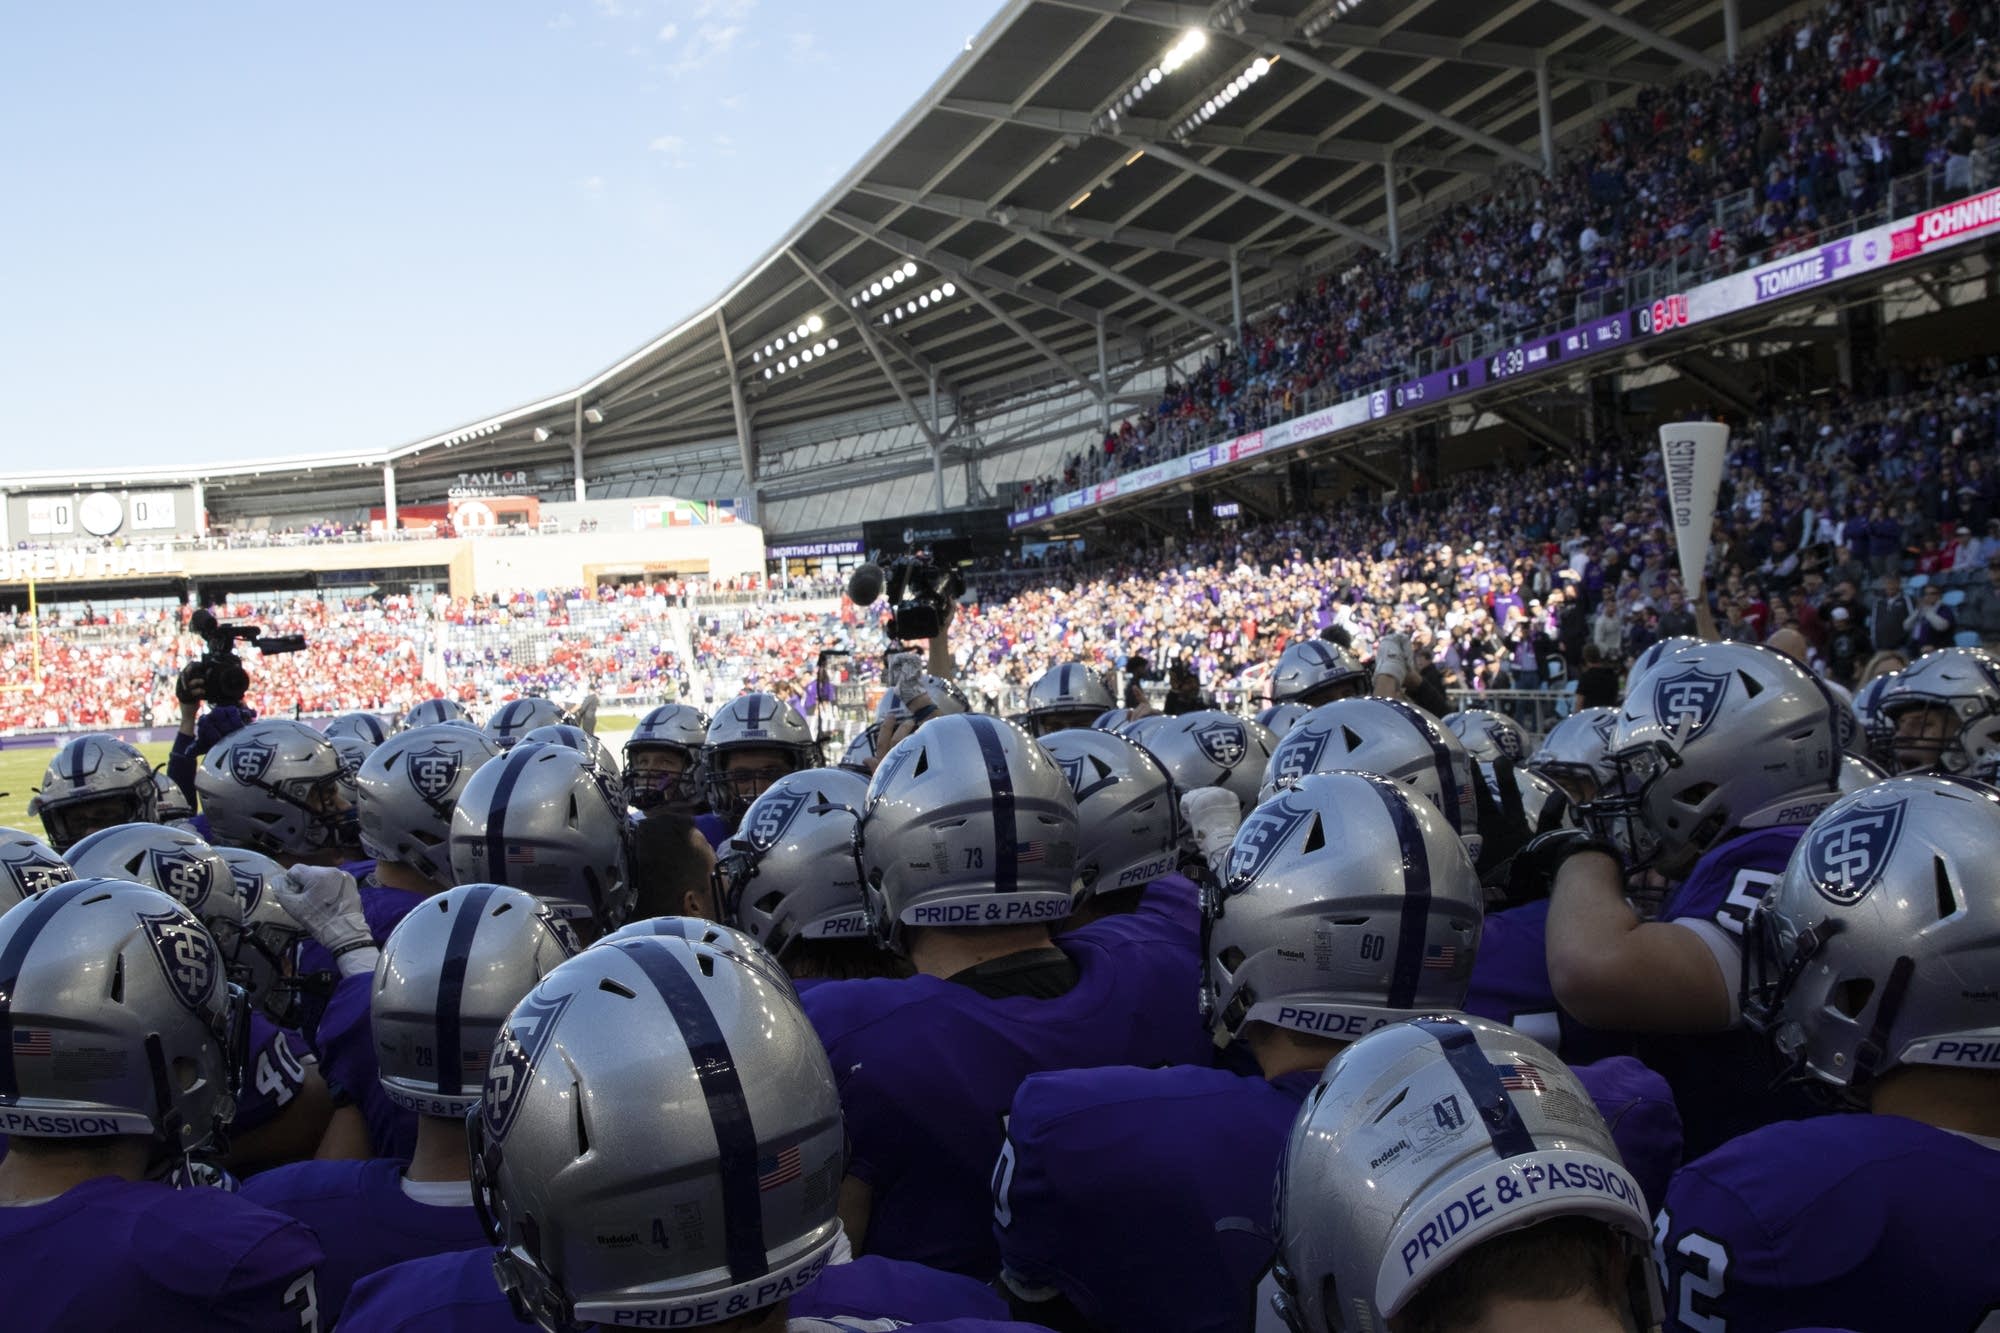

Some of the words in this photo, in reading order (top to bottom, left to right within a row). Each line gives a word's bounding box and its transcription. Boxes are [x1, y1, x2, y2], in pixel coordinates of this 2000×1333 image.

[1759, 256, 1825, 297] TOMMIE
[1639, 310, 1650, 332] 0
[1652, 294, 1689, 334] SJU
[1491, 349, 1524, 378] 4:39
[458, 471, 527, 486] TAYLOR
[1666, 440, 1696, 502] TOMMIES
[1676, 507, 1691, 527] GO
[773, 545, 825, 557] NORTHEAST
[827, 542, 859, 554] ENTRY
[965, 847, 983, 869] 73
[1119, 859, 1166, 886] PRIDE
[822, 917, 866, 935] PRID
[914, 904, 979, 923] PRIDE
[984, 903, 1000, 920] &
[1360, 933, 1385, 961] 60
[1277, 1007, 1367, 1035] PRIDE
[255, 1031, 305, 1107] 40
[6, 1113, 121, 1134] PASSION
[1433, 1094, 1466, 1130] 47
[1369, 1139, 1411, 1170] Riddell
[1400, 1184, 1494, 1277] PRIDE
[1497, 1175, 1523, 1205] &
[1521, 1161, 1642, 1218] PASSION
[652, 1218, 670, 1249] 4
[613, 1297, 719, 1328] PRIDE
[726, 1294, 750, 1315] &
